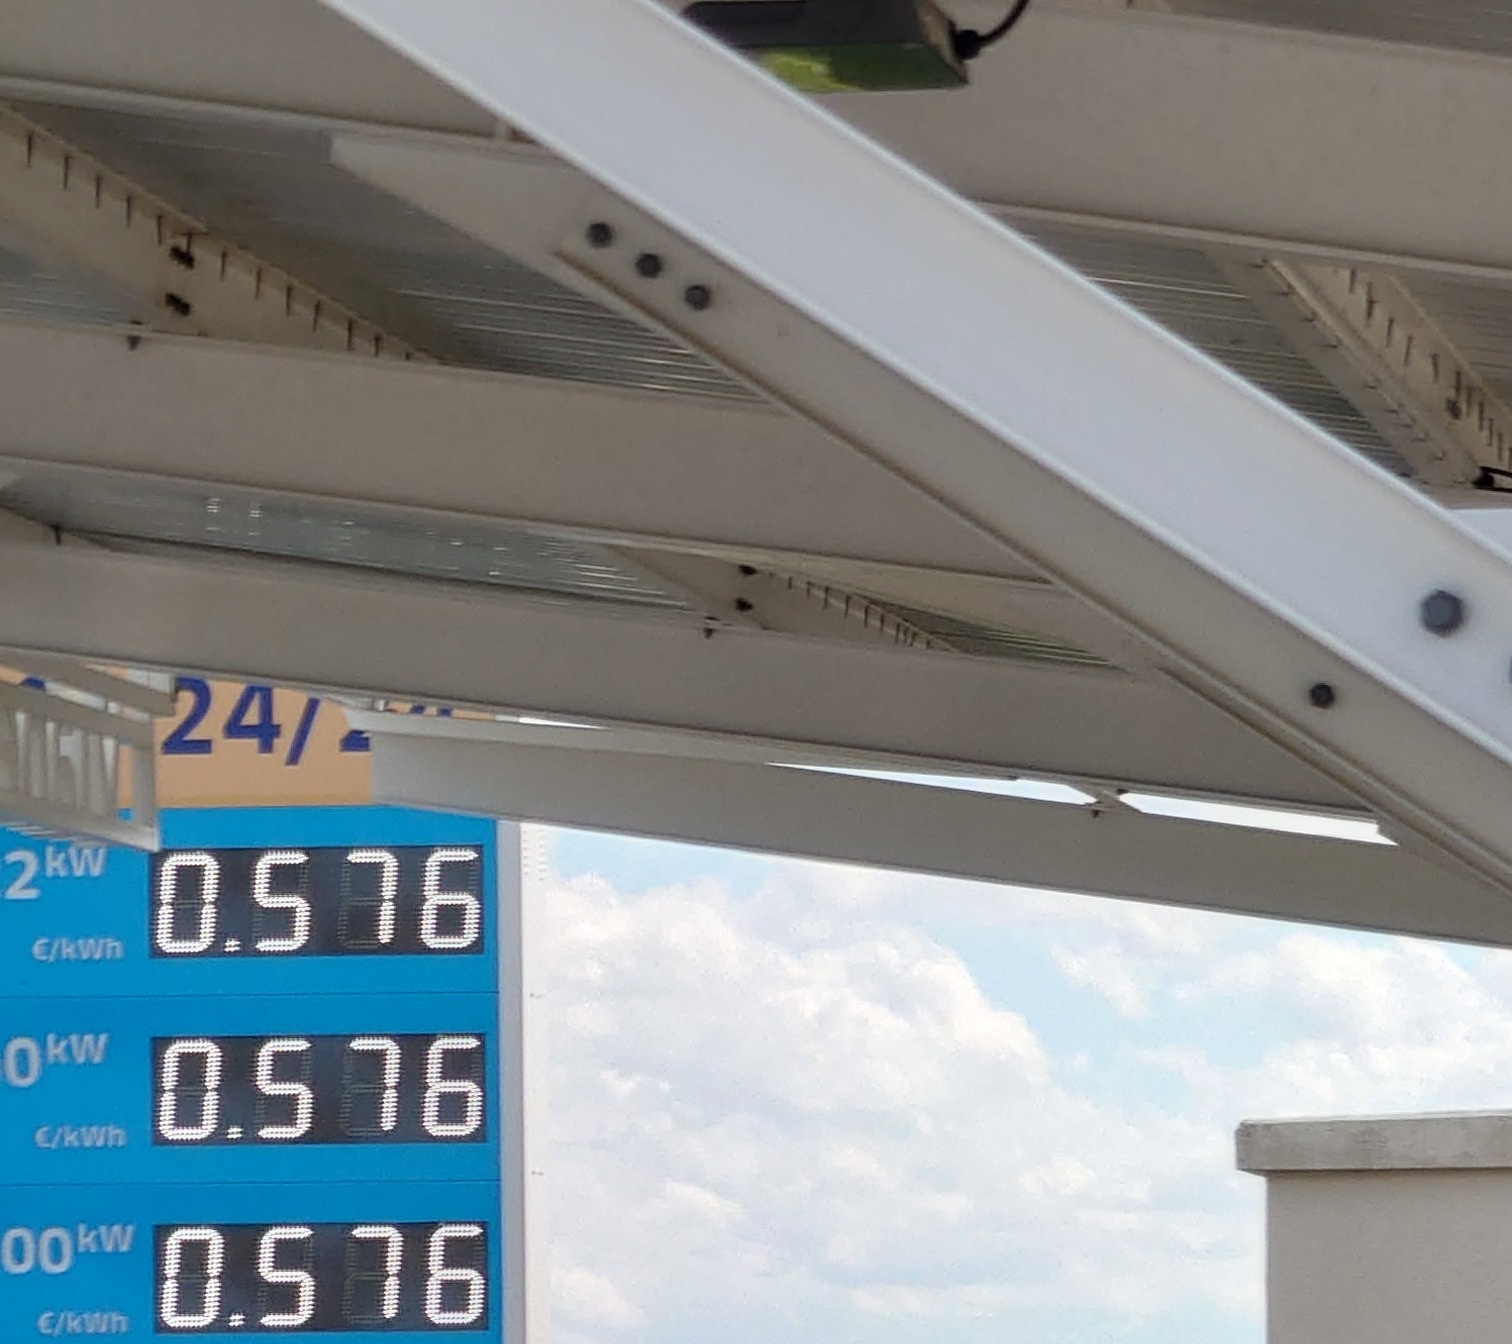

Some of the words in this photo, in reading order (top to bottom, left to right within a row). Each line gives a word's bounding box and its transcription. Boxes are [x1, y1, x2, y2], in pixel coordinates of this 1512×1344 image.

[155, 850, 484, 954] 0.576
[31, 938, 124, 962] €/kWh
[158, 1037, 485, 1140] 0.576
[34, 1125, 128, 1148] €/kWh
[160, 1223, 487, 1328] 0.576
[37, 1312, 130, 1335] €/kWh
